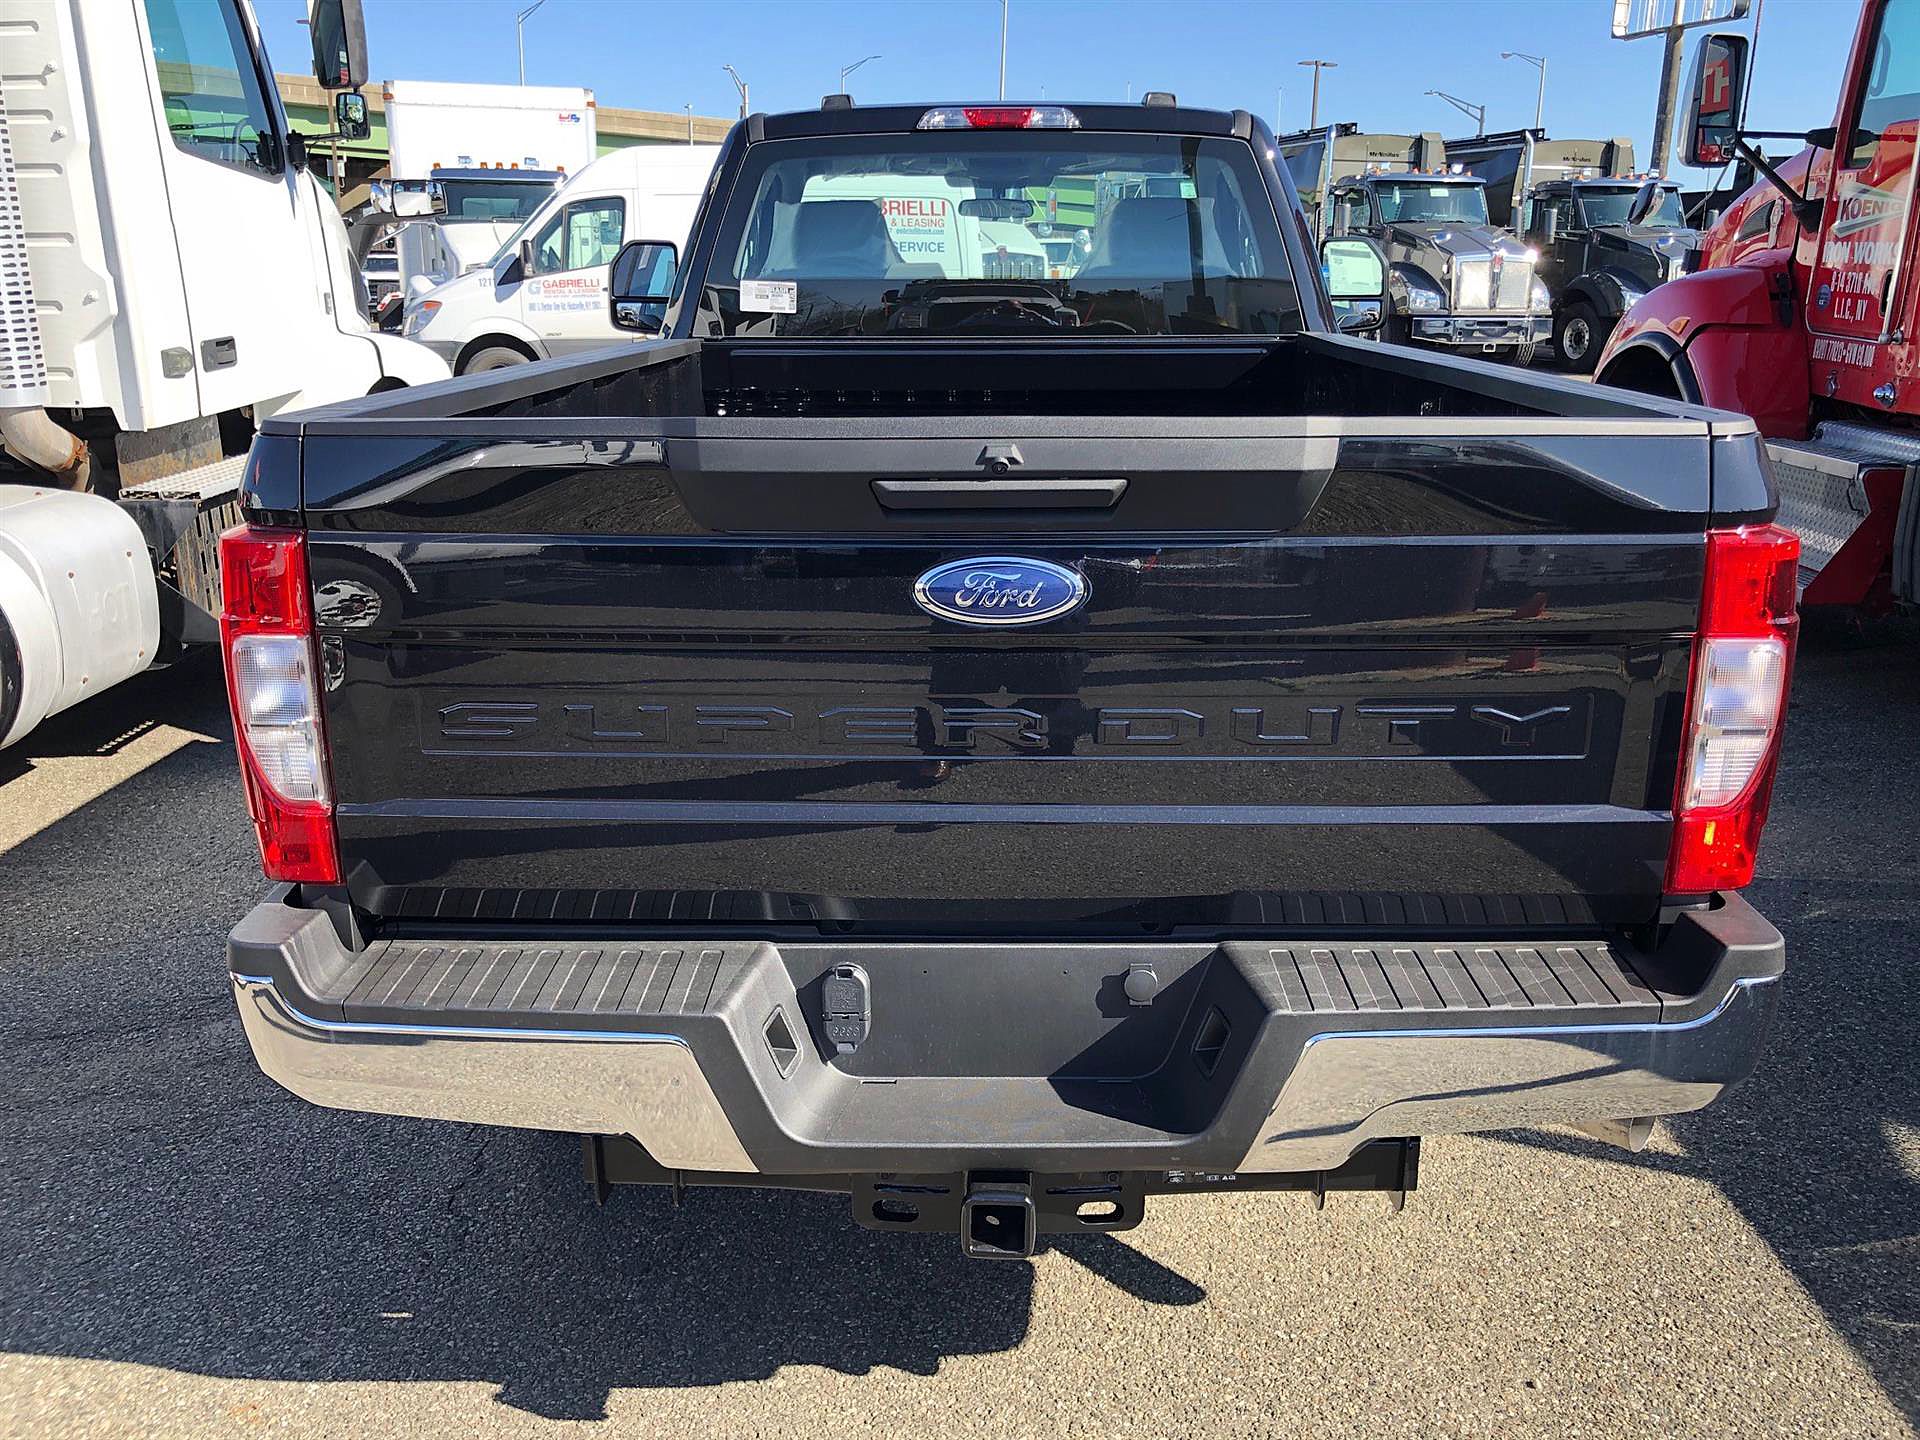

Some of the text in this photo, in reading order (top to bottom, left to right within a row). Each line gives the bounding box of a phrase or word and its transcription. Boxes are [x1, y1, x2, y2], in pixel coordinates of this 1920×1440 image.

[881, 200, 945, 216] BRIELLI
[901, 217, 945, 228] LEASING
[542, 278, 600, 289] GABRIELLI
[1855, 300, 1868, 321] NY
[954, 571, 1043, 608] Ford
[440, 702, 1572, 747] SUPER DUTY
